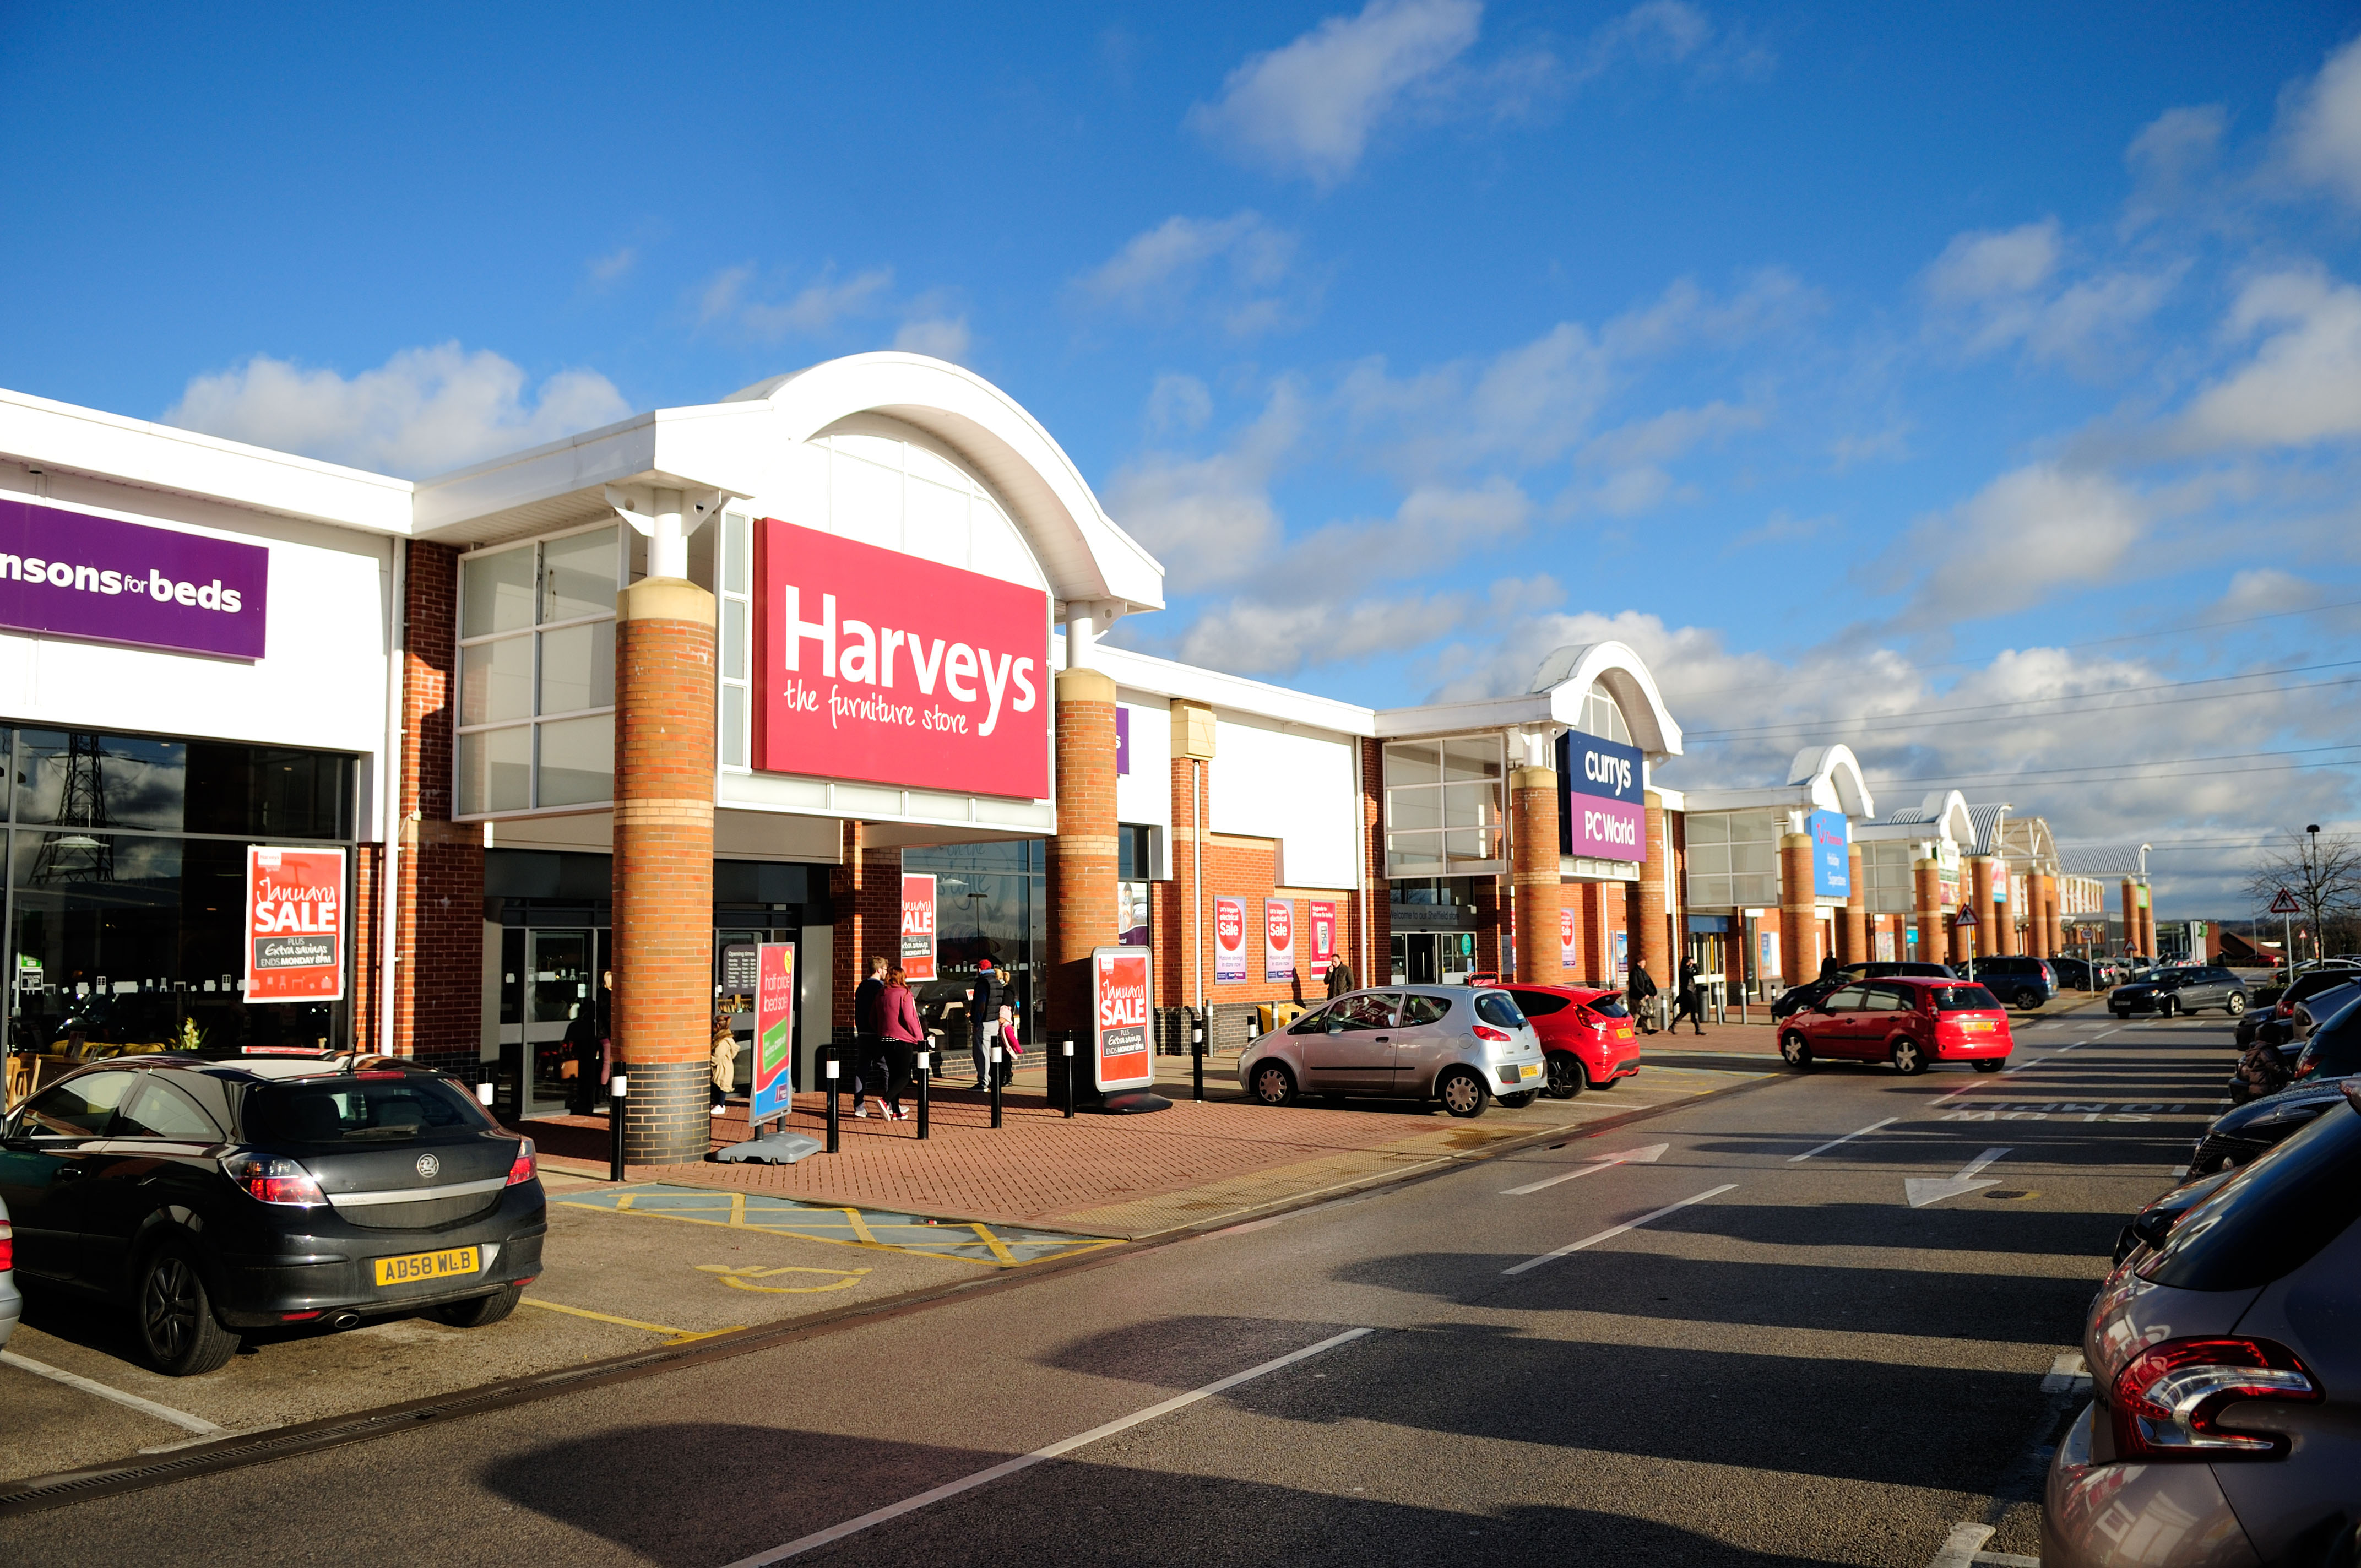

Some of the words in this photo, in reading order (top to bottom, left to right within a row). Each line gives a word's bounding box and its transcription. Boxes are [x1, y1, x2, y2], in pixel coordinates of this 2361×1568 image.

[124, 574, 148, 594] for
[150, 569, 242, 613] beds
[785, 584, 1036, 737] Harveys
[784, 679, 819, 712] the
[828, 683, 916, 729] furniture
[922, 704, 968, 734] store
[1584, 750, 1632, 797] currys
[1584, 810, 1603, 842] PC
[1603, 813, 1635, 846] World
[257, 876, 335, 903] January
[256, 901, 337, 932] SALE
[1220, 921, 1239, 936] Sale
[1270, 923, 1287, 936] Sale
[261, 958, 280, 967] ENDS
[281, 956, 314, 965] MONDAY
[265, 943, 295, 956] Extra
[295, 943, 328, 956] savings
[1101, 979, 1144, 1002] January
[1101, 999, 1146, 1026] SALE
[1939, 1110, 2153, 1122] SLOW
[385, 1257, 432, 1281] AD58
[437, 1251, 471, 1273] WLB
